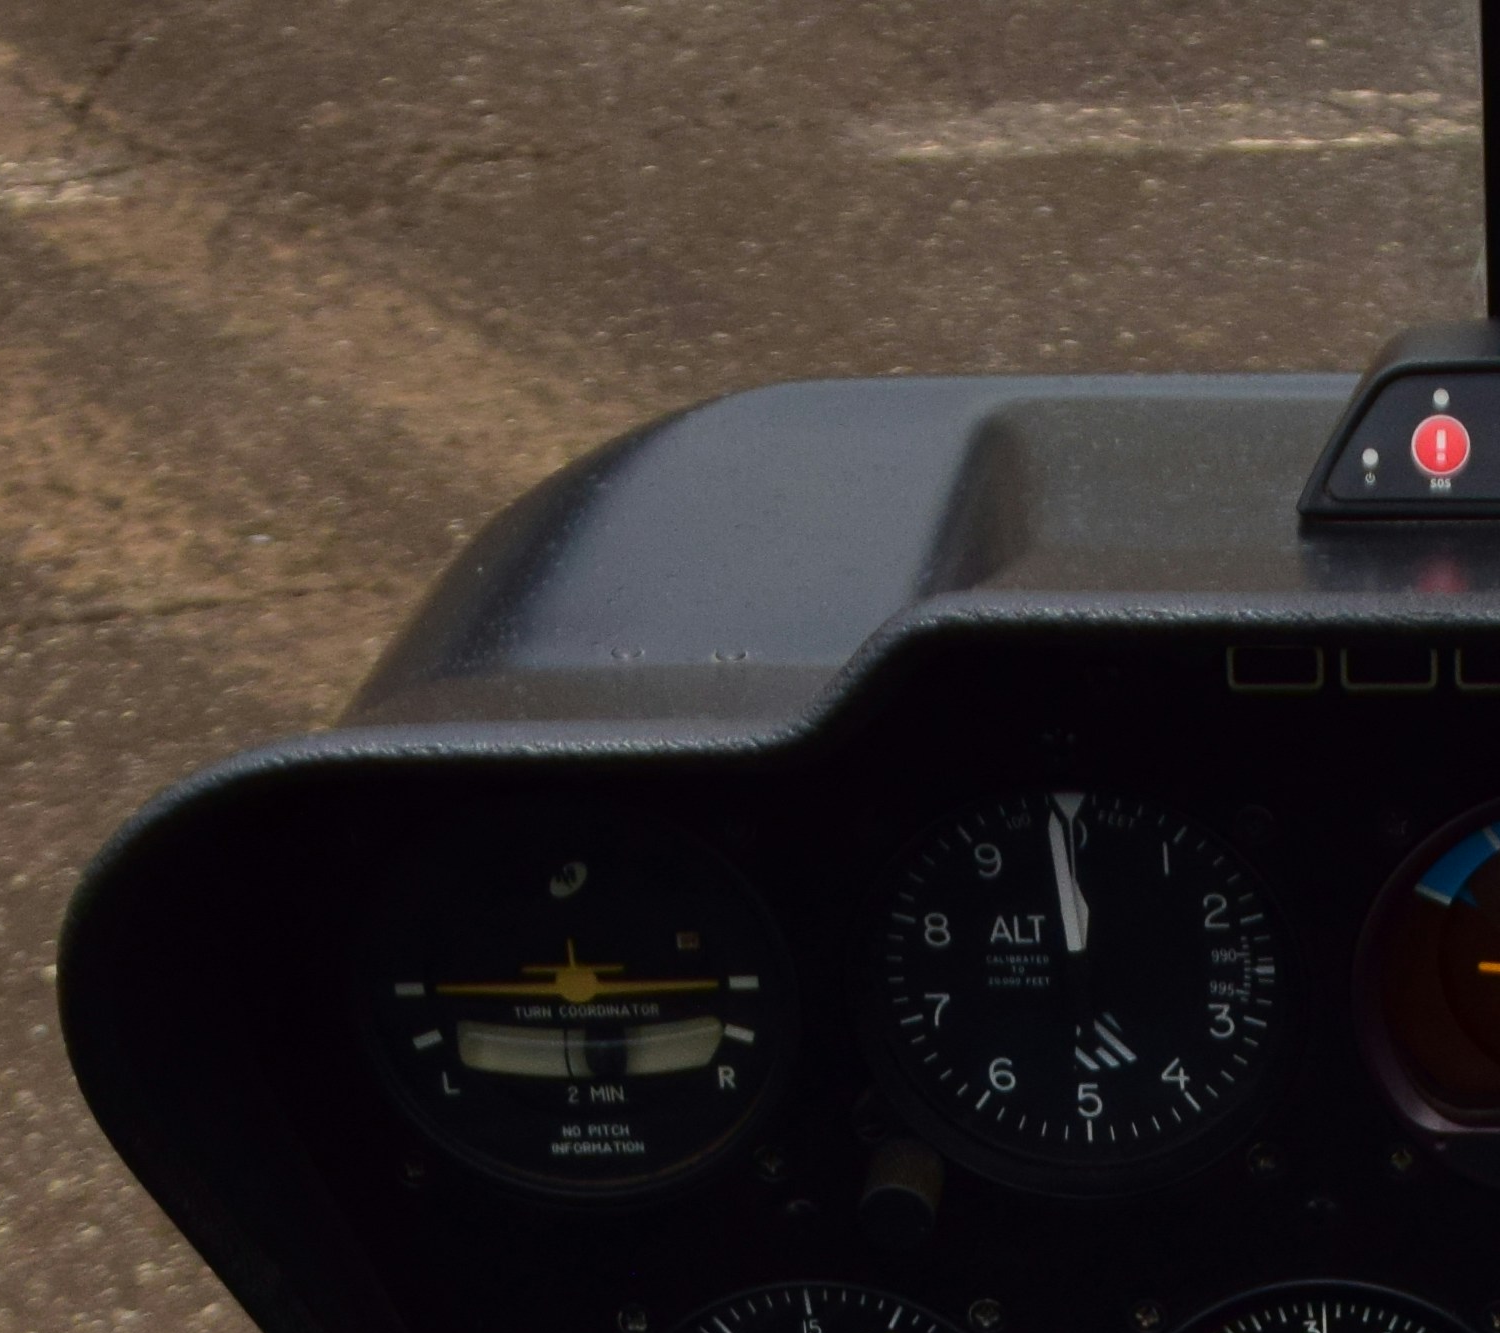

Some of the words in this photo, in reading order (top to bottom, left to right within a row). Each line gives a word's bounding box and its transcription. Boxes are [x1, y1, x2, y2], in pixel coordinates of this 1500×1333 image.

[1430, 478, 1451, 489] SOS
[990, 915, 1046, 944] ALT
[514, 1005, 551, 1019] TURN
[559, 1003, 660, 1018] COORDINATOR
[443, 1071, 460, 1096] L
[718, 1065, 736, 1089] R
[568, 1086, 579, 1103] 2
[591, 1085, 625, 1103] MIN
[562, 1126, 581, 1137] NO
[588, 1124, 630, 1137] PITCH
[551, 1141, 645, 1154] INFORMATION
